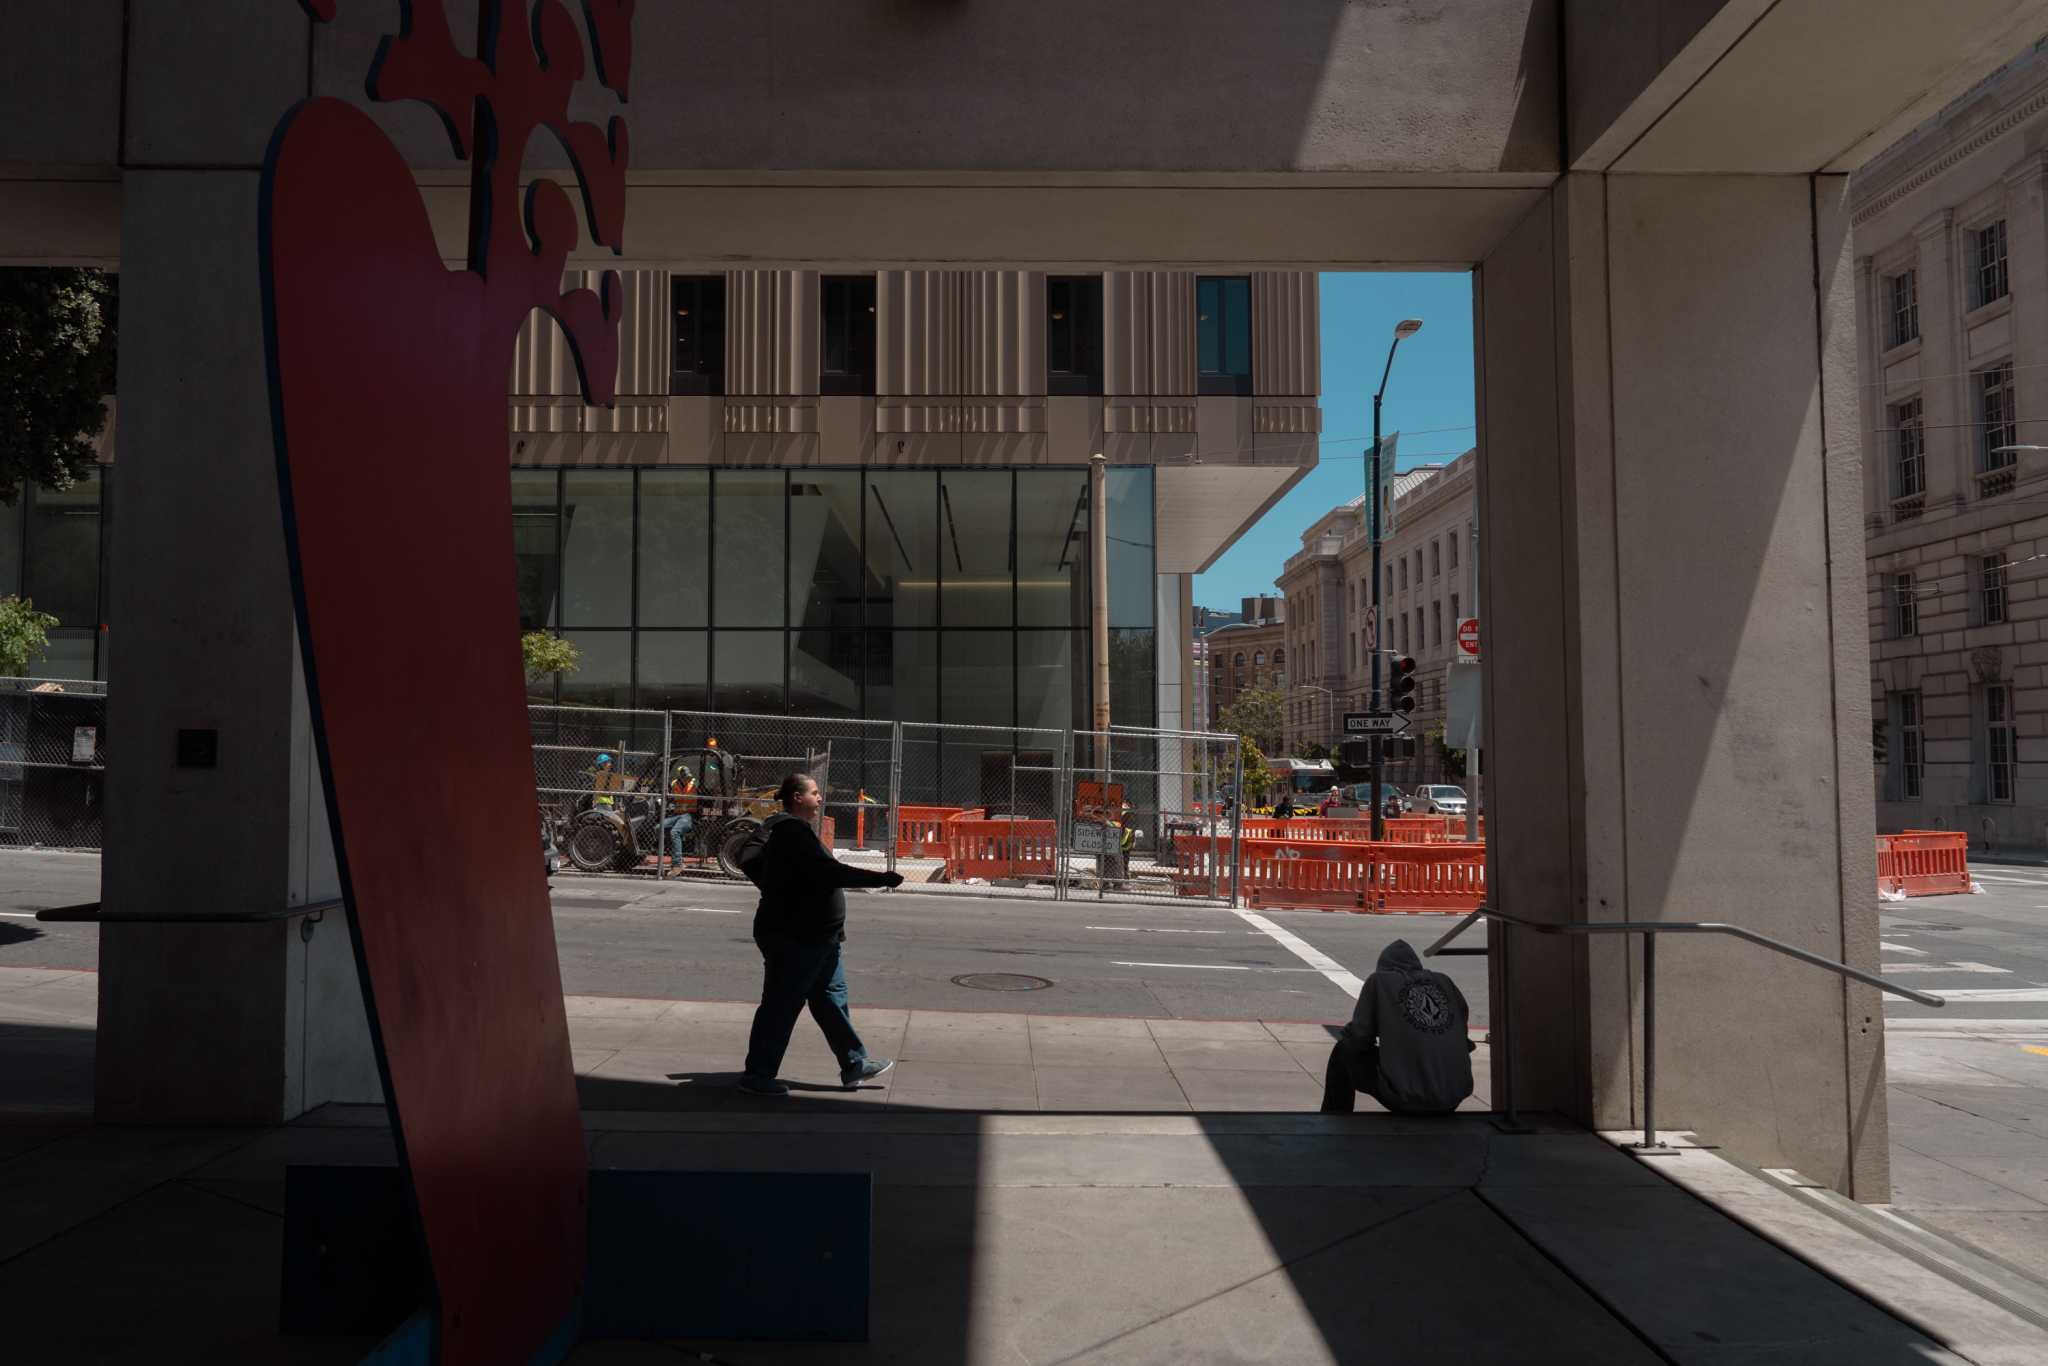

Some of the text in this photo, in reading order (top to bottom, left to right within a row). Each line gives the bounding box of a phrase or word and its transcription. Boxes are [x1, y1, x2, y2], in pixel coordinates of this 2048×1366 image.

[1465, 640, 1478, 648] ENT
[1350, 719, 1391, 728] ONE WAY
[1081, 840, 1113, 849] CLOSD
